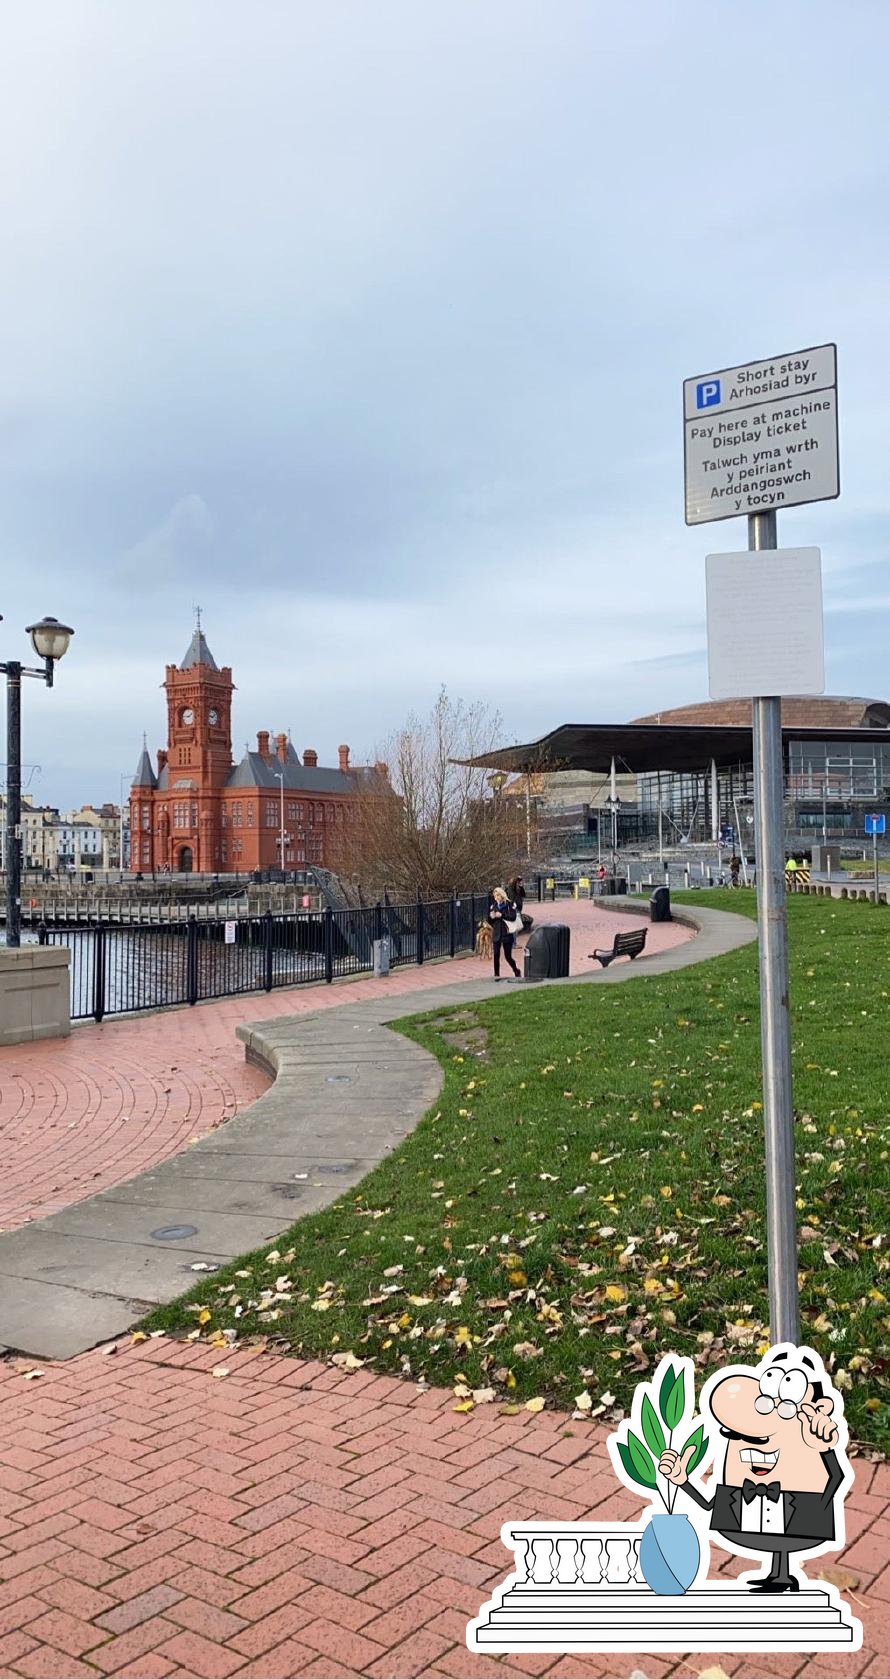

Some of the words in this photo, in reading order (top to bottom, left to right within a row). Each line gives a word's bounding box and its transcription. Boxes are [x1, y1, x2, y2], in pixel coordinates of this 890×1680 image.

[729, 378, 789, 400] Arhosiad
[795, 371, 817, 386] byr
[736, 365, 775, 383] Short
[780, 359, 810, 374] stay
[702, 383, 718, 405] P
[691, 427, 714, 439] Pay
[718, 419, 748, 434] here
[753, 413, 766, 426] at
[772, 400, 831, 422] machine
[713, 430, 761, 448] Display
[767, 418, 807, 437] ticket
[702, 453, 748, 472] Talwch
[753, 448, 781, 464] yma
[786, 438, 819, 454] wrth
[710, 469, 812, 499] Arddangoswch
[727, 472, 734, 483] y
[739, 458, 792, 481] peiriant
[734, 499, 742, 510] y
[747, 491, 785, 507] tocyn
